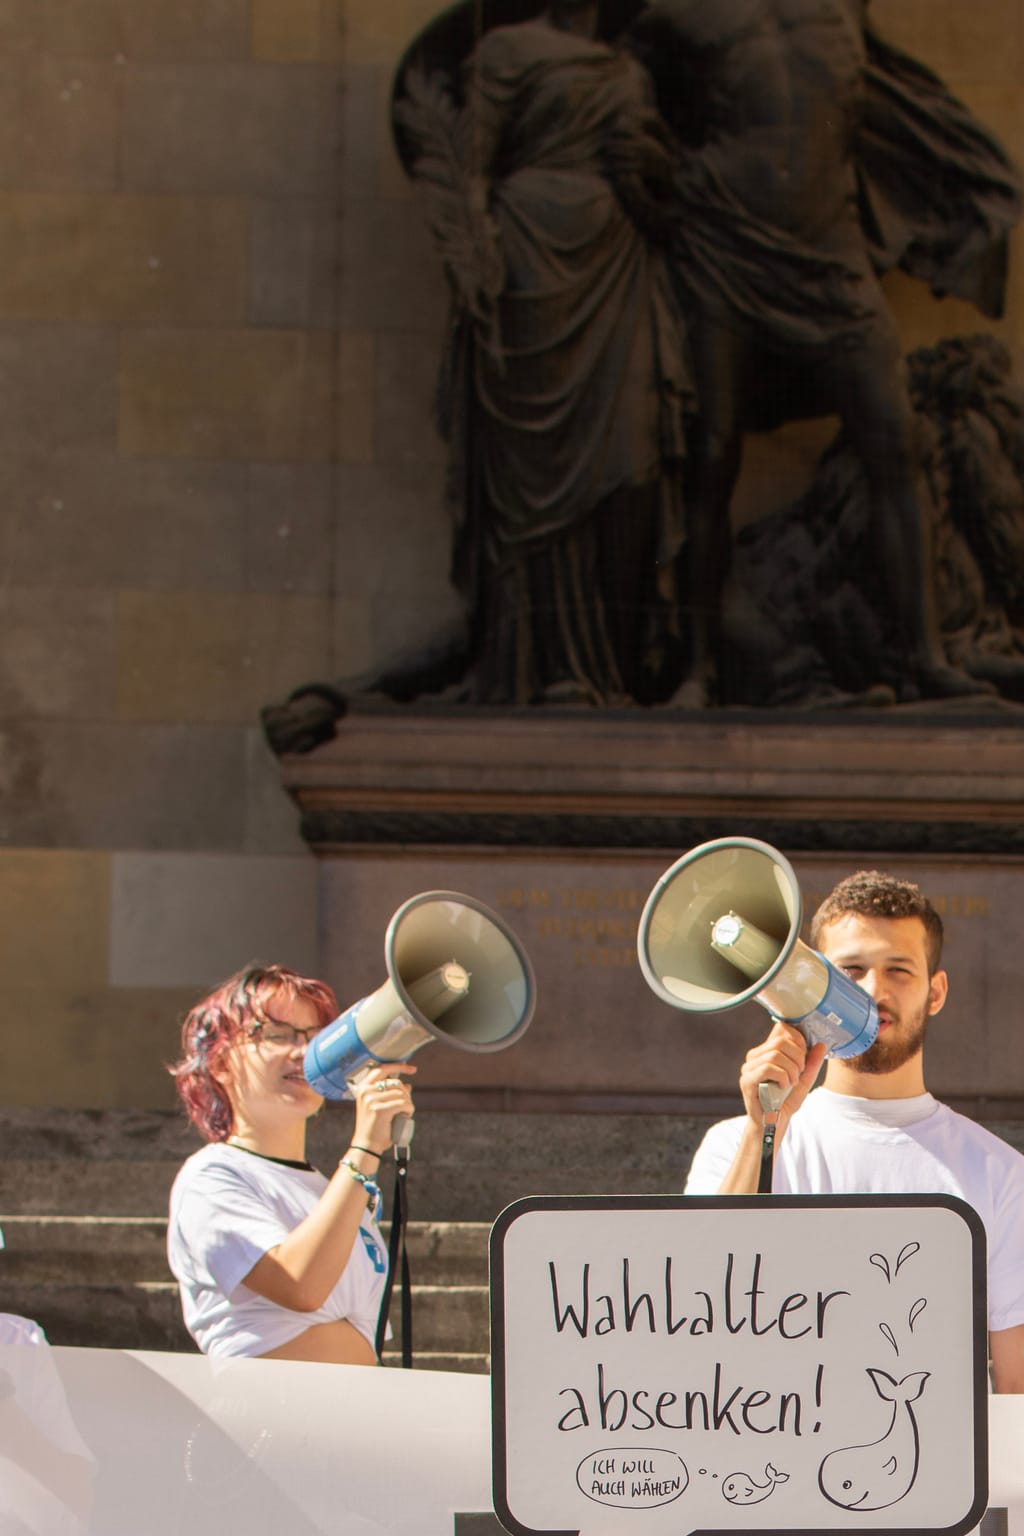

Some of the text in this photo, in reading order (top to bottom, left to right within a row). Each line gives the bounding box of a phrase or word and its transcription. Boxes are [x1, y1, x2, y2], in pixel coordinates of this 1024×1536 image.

[548, 1252, 852, 1339] Wahlalter
[556, 1362, 825, 1437] absenken!
[591, 1476, 681, 1498] AUCH WÄHLEN
[592, 1458, 656, 1475] ICH WILL
